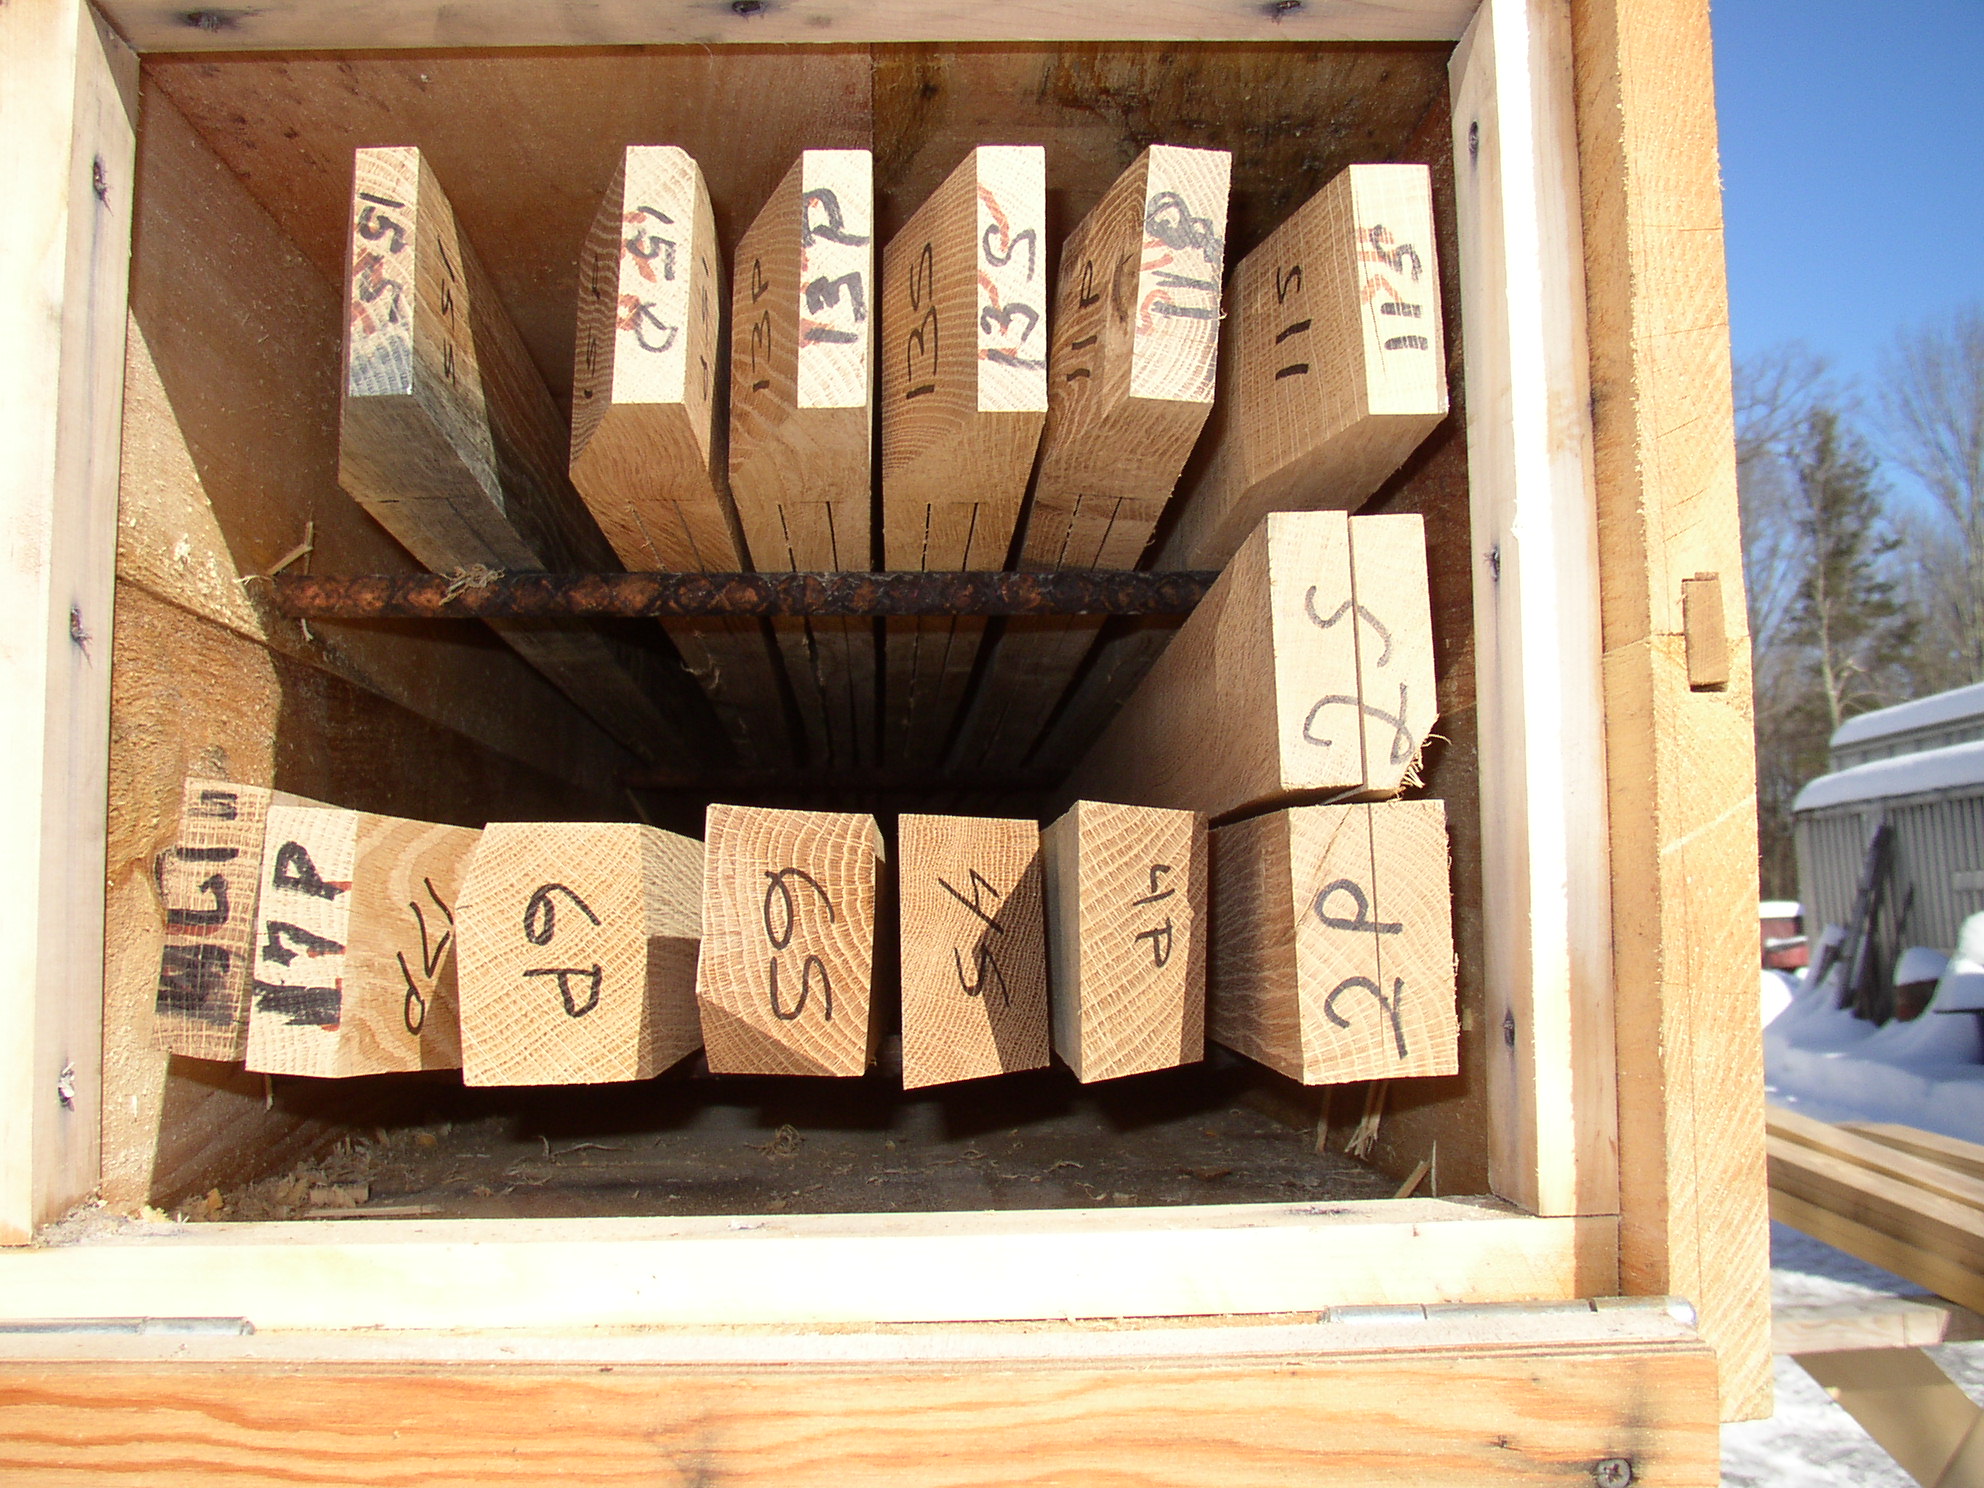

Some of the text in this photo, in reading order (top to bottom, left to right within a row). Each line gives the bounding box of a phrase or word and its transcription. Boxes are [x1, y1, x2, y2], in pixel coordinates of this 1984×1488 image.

[750, 258, 771, 393] 13P
[802, 187, 870, 345] 13P
[1132, 864, 1175, 969] 4P
[1314, 878, 1408, 1060] 2P
